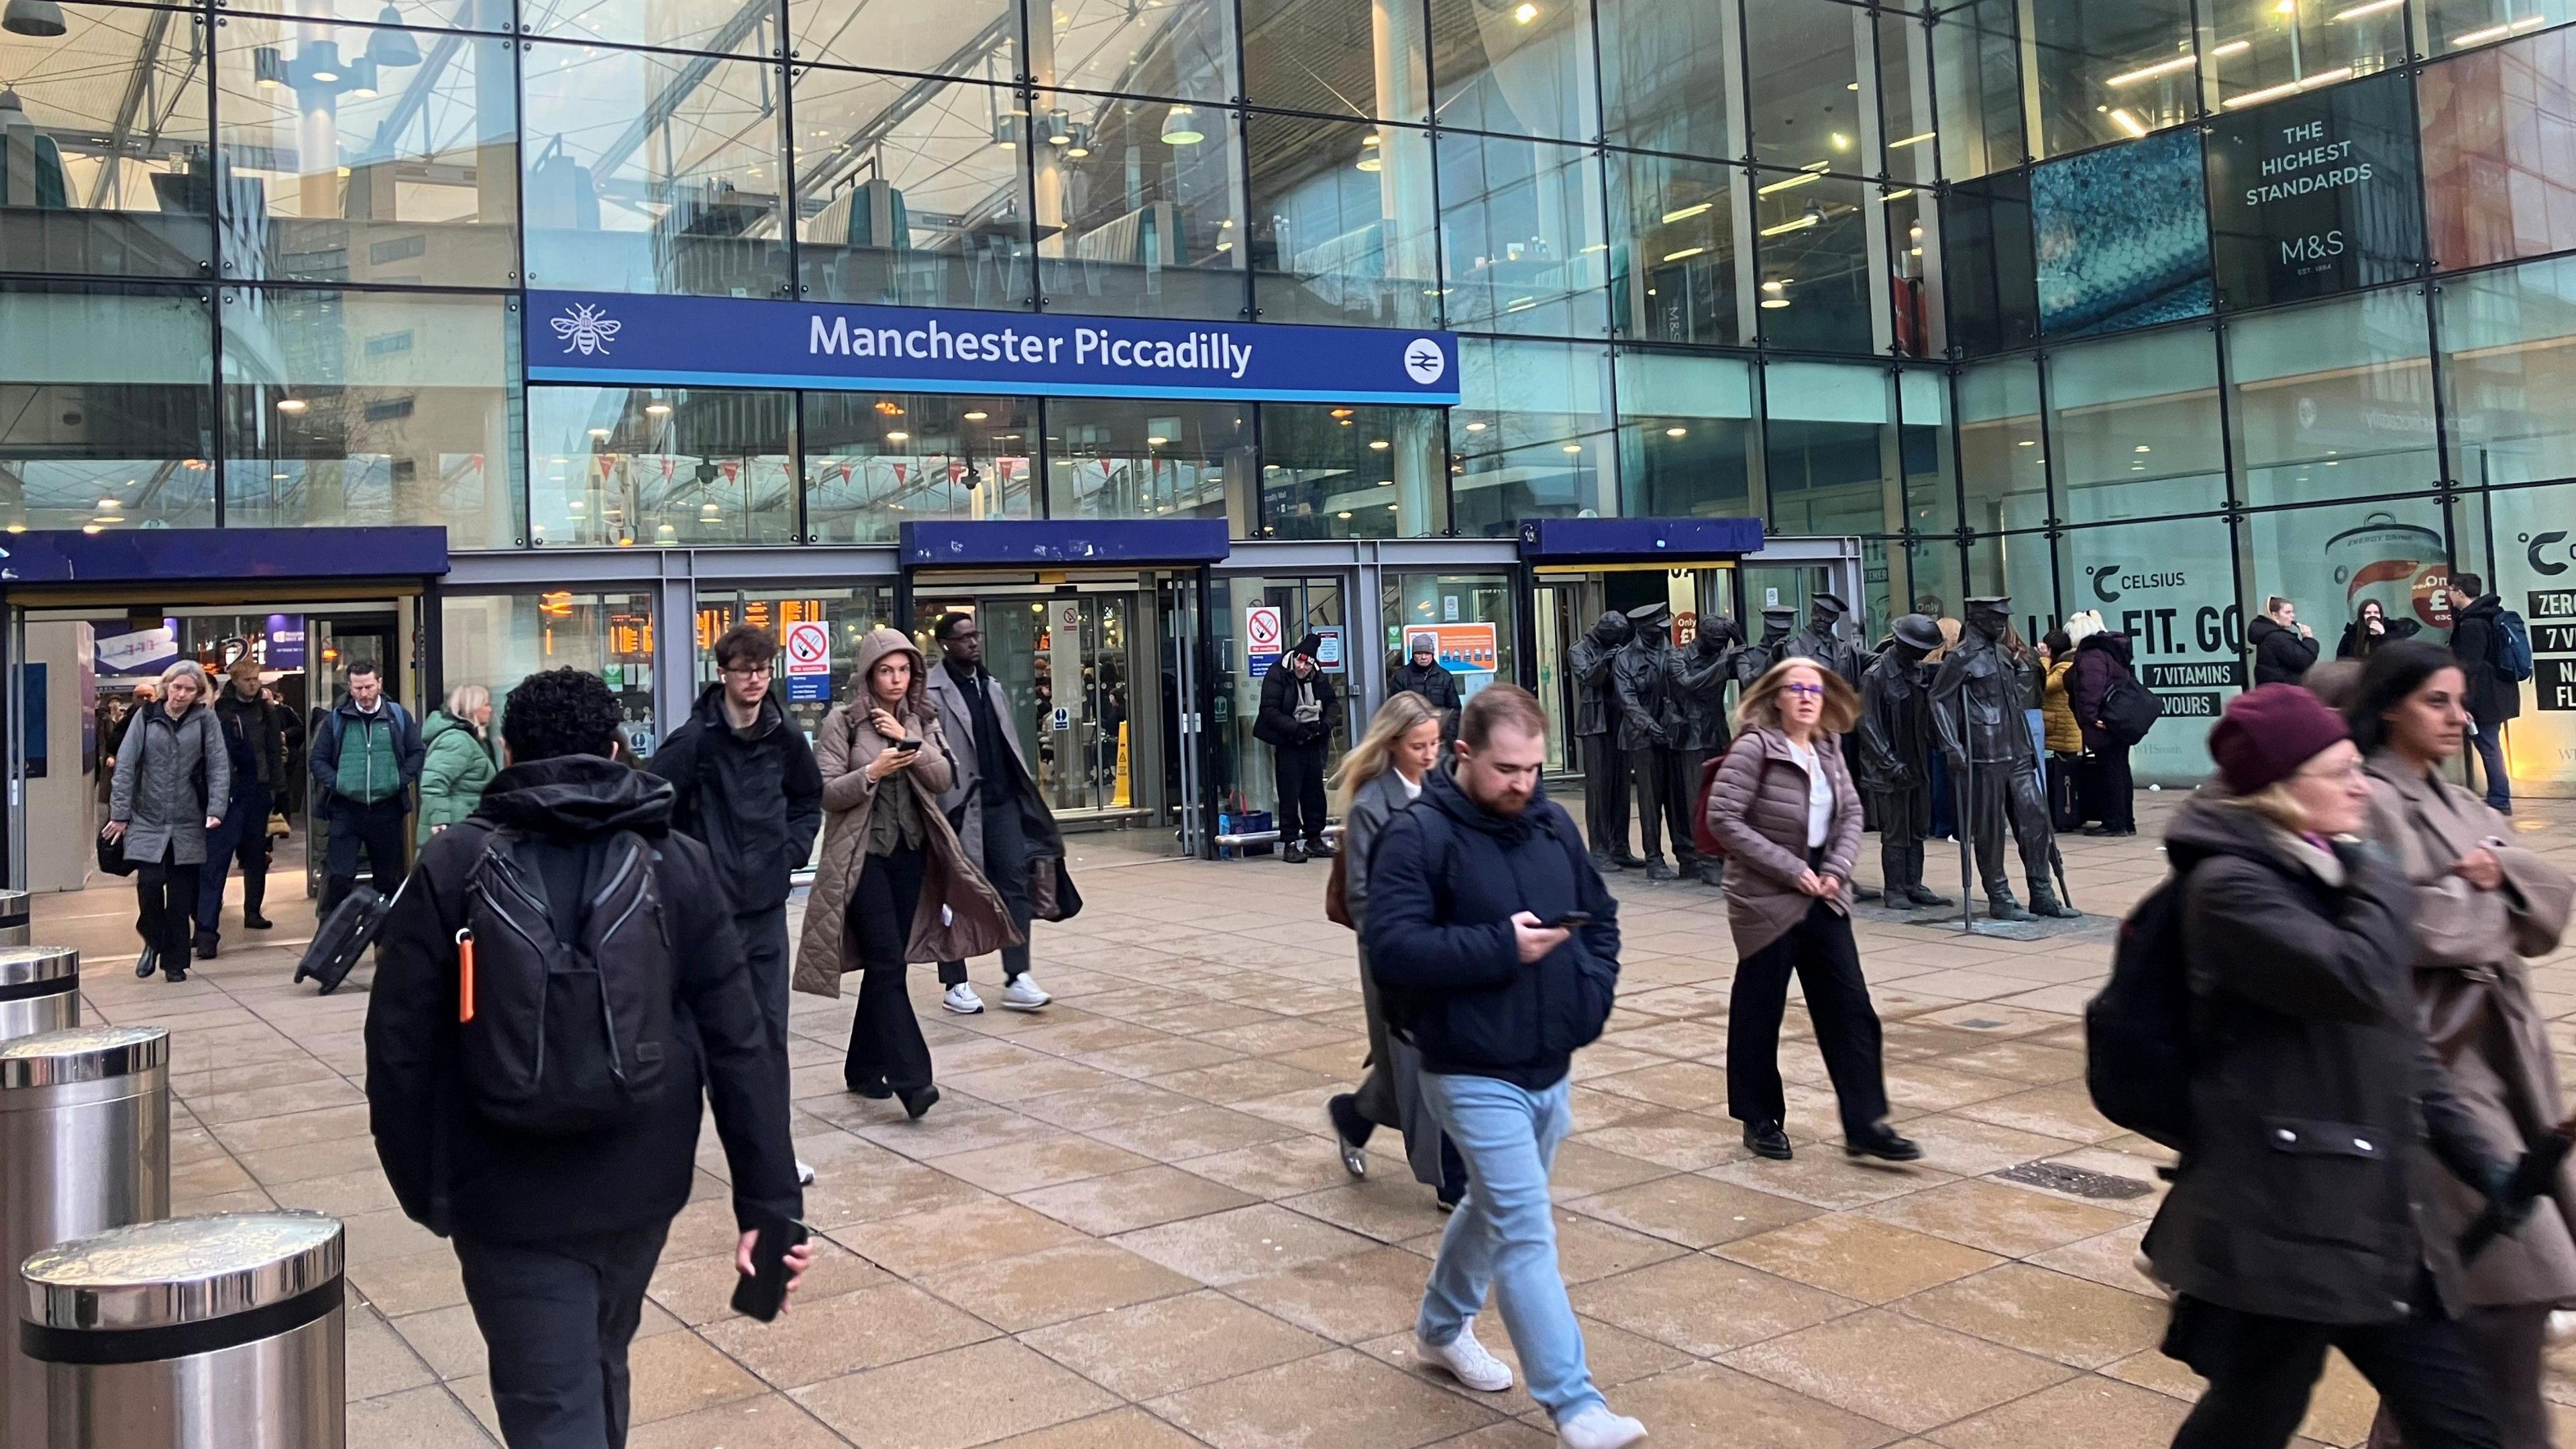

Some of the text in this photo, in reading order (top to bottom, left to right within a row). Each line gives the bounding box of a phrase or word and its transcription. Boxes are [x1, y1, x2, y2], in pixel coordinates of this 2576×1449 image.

[2283, 121, 2324, 144] THE
[2262, 140, 2351, 176] HIGHEST
[2246, 163, 2373, 205] STANDARDS
[2282, 231, 2344, 264] M&S
[809, 315, 1252, 378] Manchester Piccadilly
[2121, 572, 2186, 590] CELSIUS
[1915, 602, 1939, 612] Only
[1678, 618, 1697, 628] Only
[2123, 608, 2186, 655] FIT.
[2546, 628, 2557, 649] 7
[2153, 665, 2231, 685] 7 VITAMINS
[2161, 696, 2210, 714] VOURS
